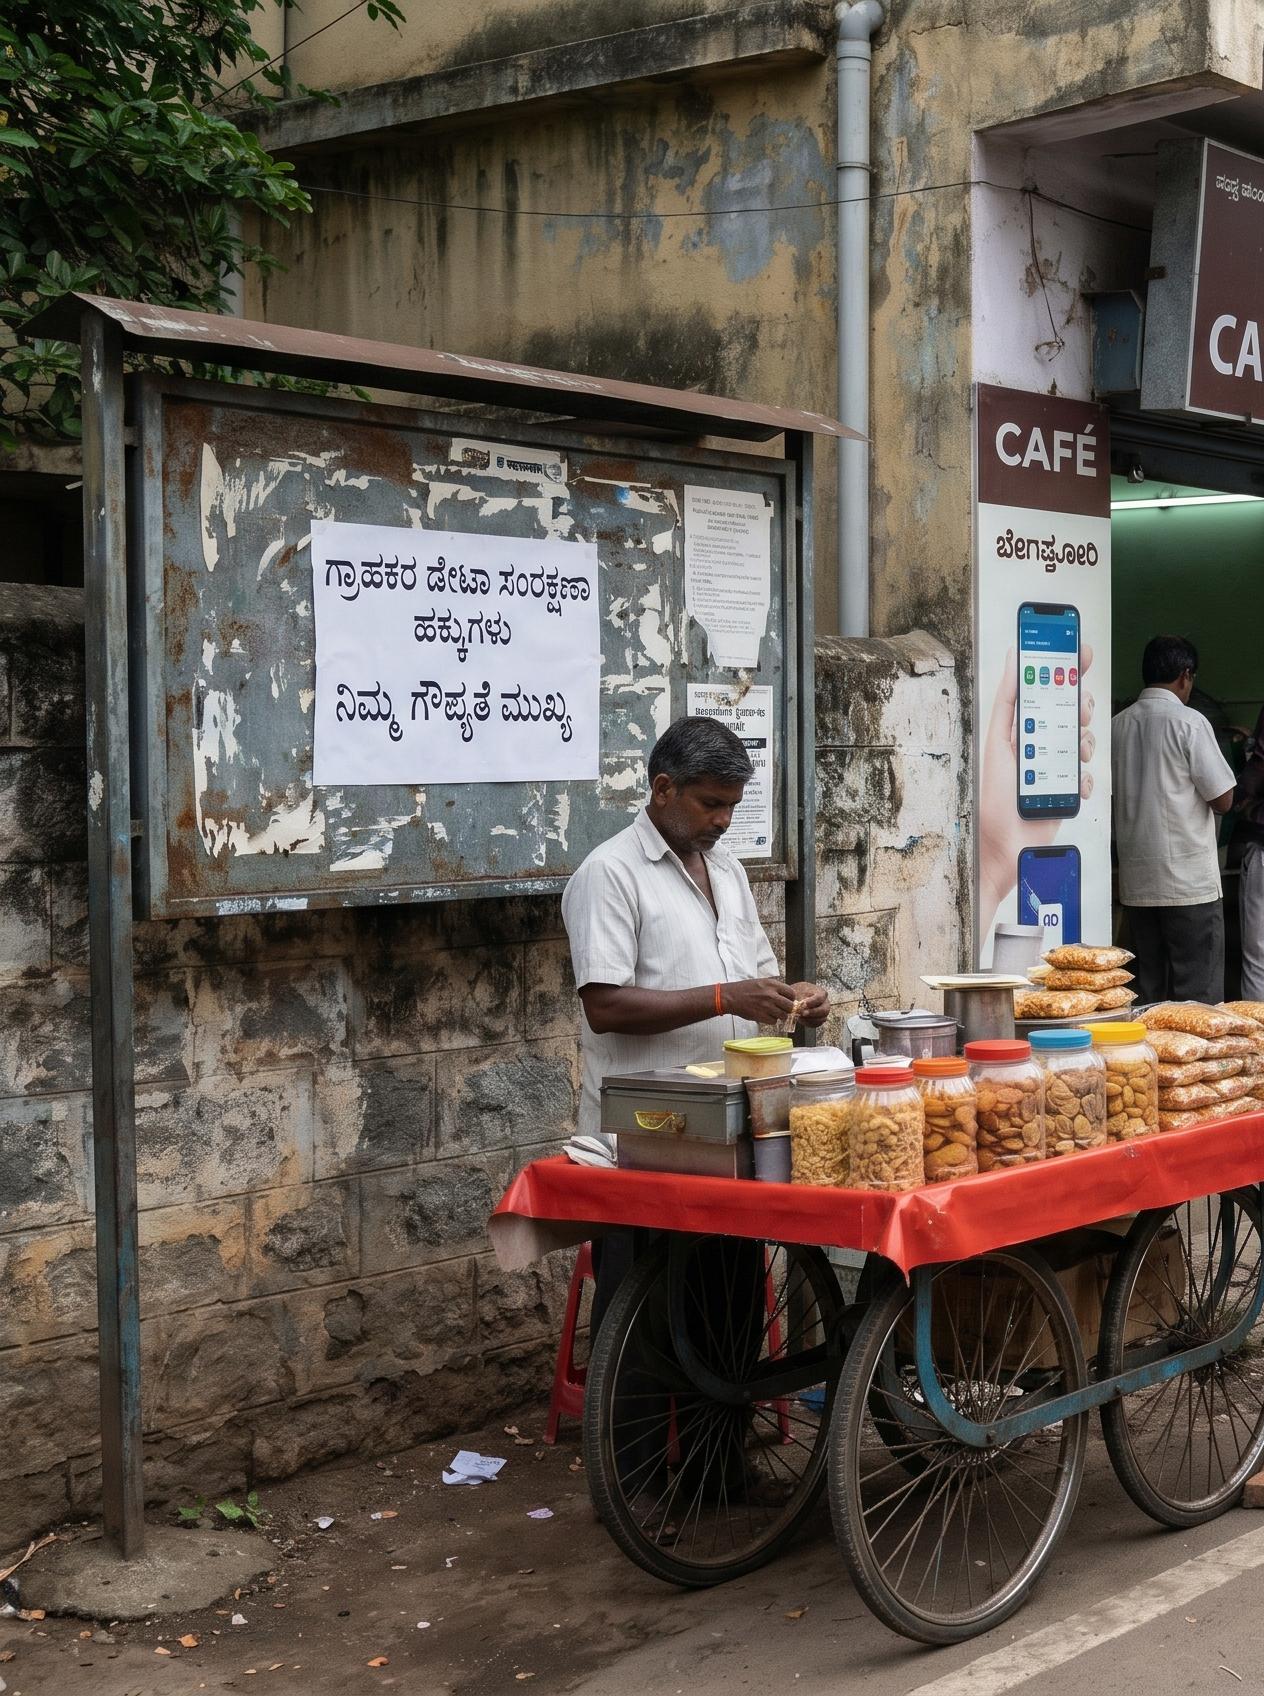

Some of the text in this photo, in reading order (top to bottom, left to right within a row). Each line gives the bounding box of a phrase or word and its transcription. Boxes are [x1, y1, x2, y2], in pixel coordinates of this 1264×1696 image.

[995, 422, 1098, 477] CAFÉ
[325, 553, 591, 617] ಗ್ರಾಹಕರ ಡೇಟಾ ಸಂರಕ್ಷಣಾ
[413, 607, 512, 663] ಹಕ್ಕುಗಳು
[335, 680, 573, 743] ನಿಮ್ಮ ಗೌಪ್ಯತೆ ಮುಖ್ಯ
